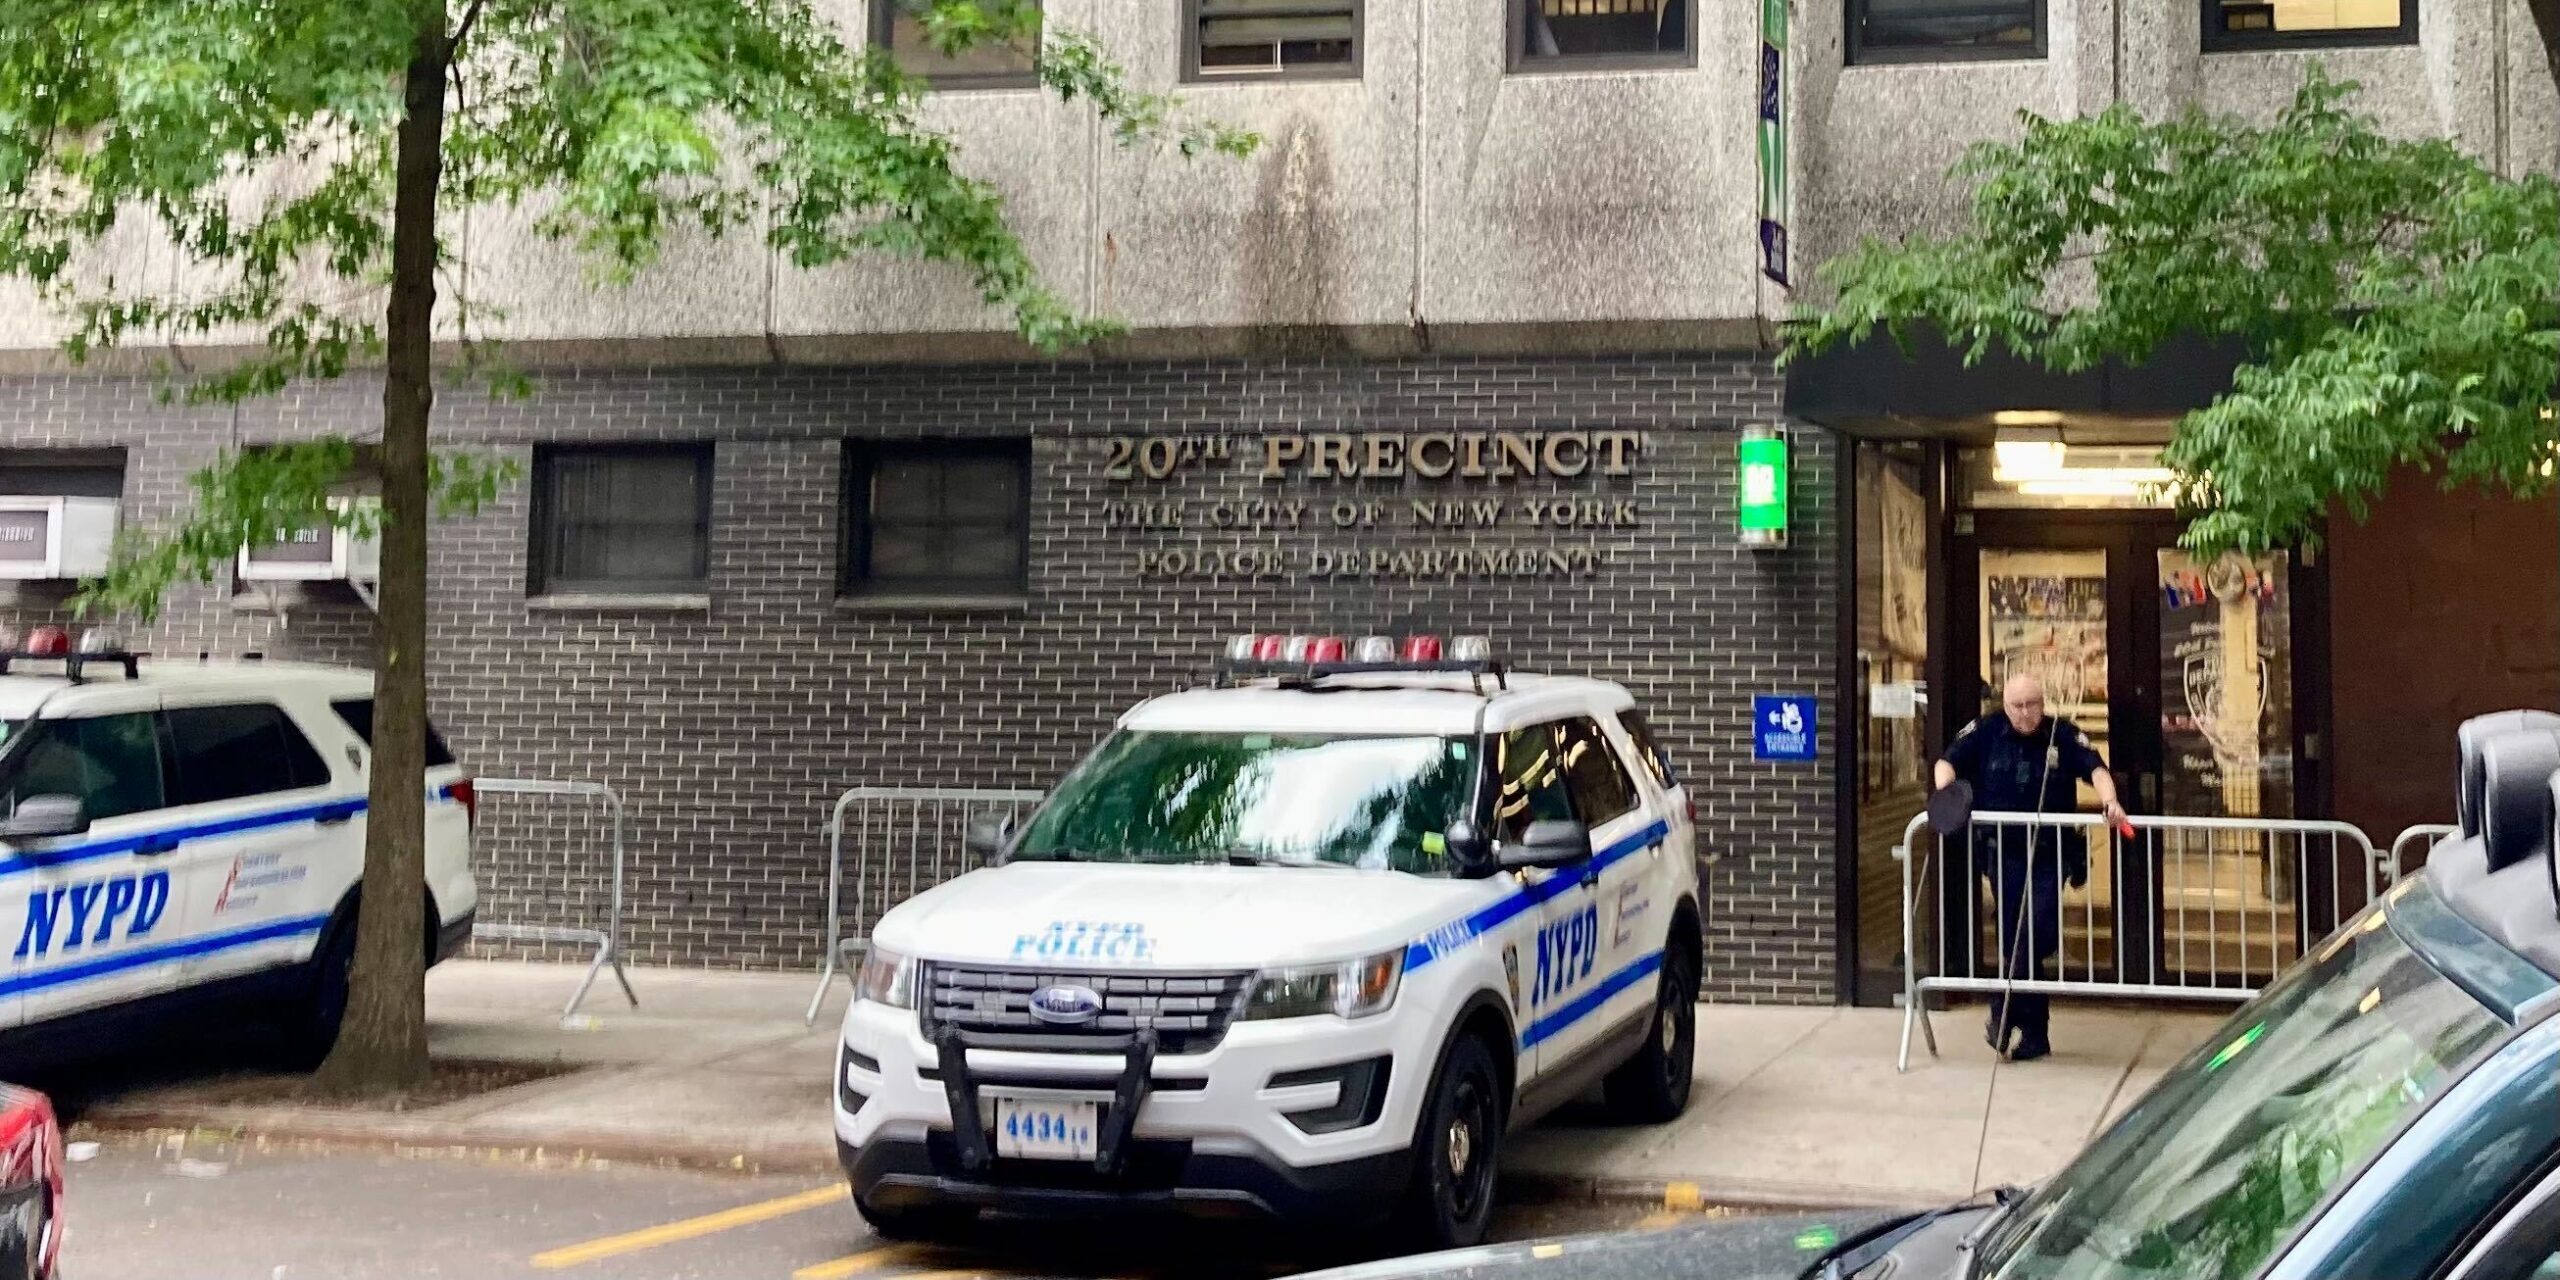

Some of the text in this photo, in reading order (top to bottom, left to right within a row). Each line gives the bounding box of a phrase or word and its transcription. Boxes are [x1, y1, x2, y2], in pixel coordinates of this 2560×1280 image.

[1102, 430, 1641, 481] 20TH PRECINCT
[1103, 500, 1639, 527] THE CITY OF NEW YORK
[1137, 546, 1602, 577] POLICE DEPARTMENT
[13, 871, 170, 961] NYPD
[1010, 933, 1158, 961] POLICE
[1427, 917, 1473, 961] POLICE
[1531, 903, 1598, 1008] NYPD
[1006, 1111, 1066, 1142] 4434
